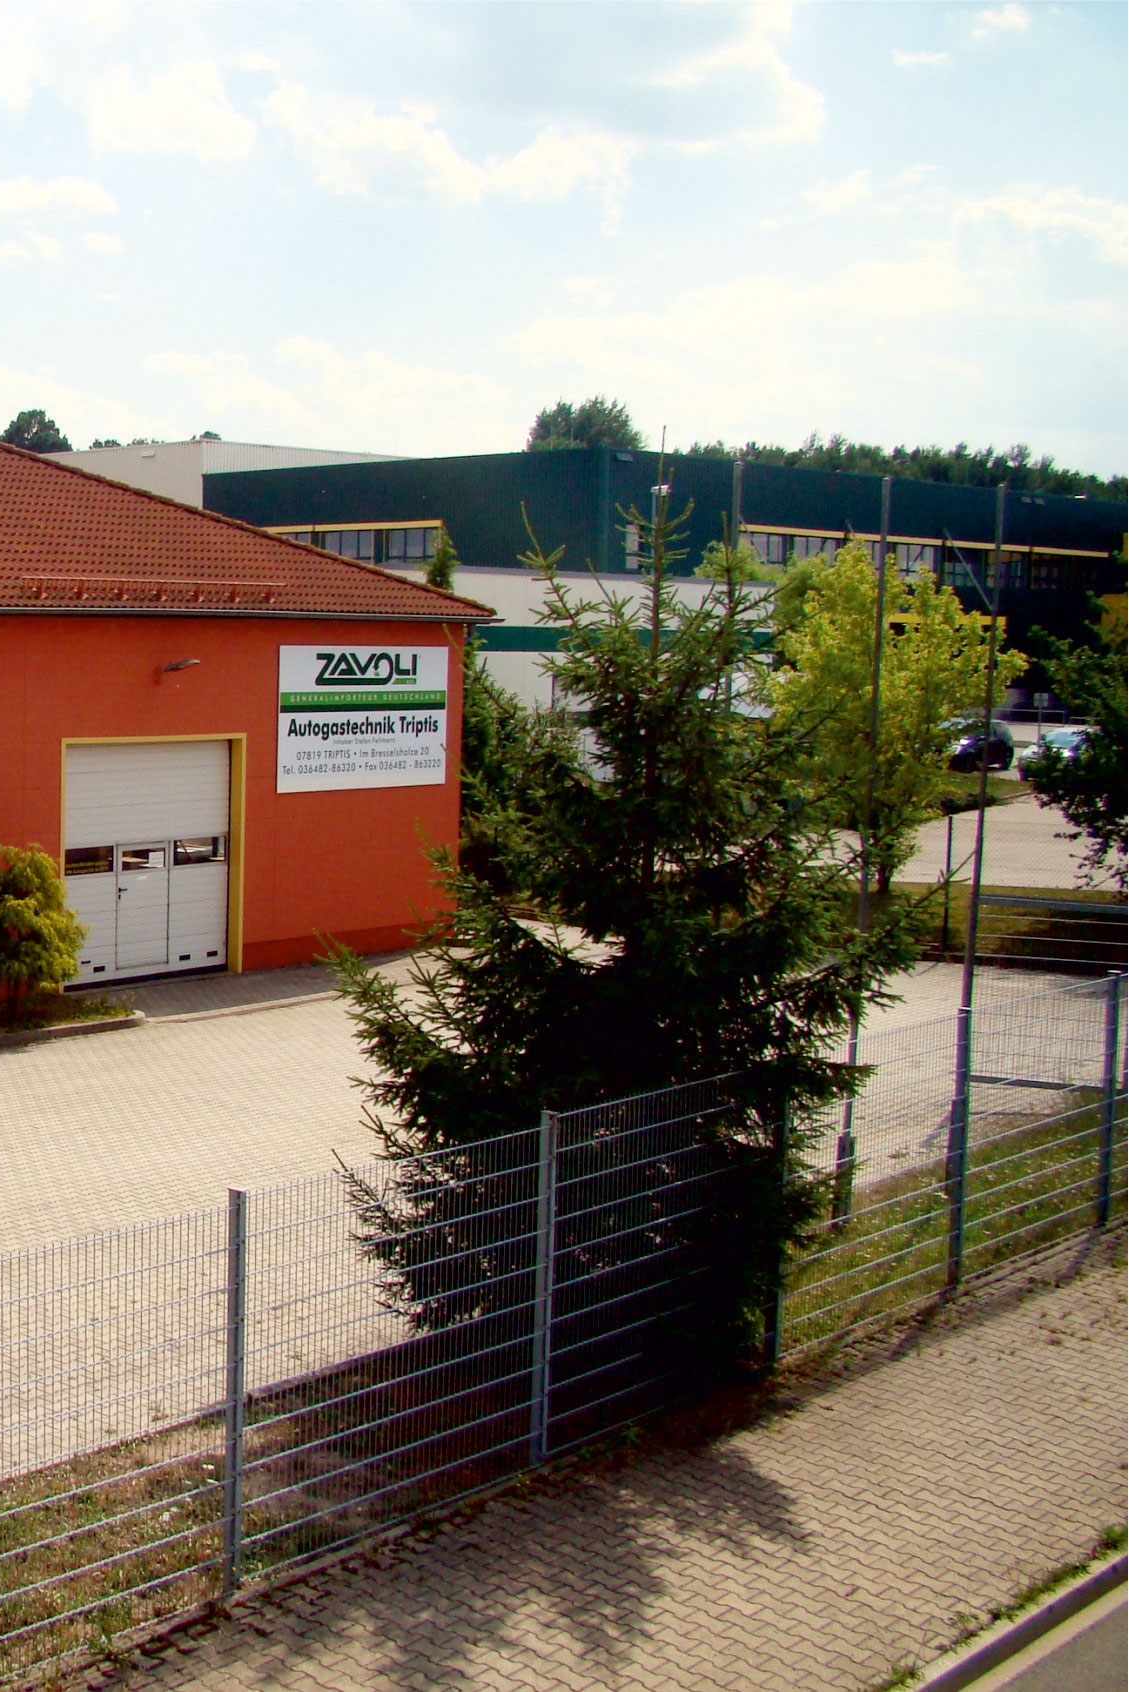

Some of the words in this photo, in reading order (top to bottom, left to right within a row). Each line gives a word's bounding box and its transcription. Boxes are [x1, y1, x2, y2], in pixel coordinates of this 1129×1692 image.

[315, 652, 418, 686] ZAVOLI
[382, 693, 442, 701] DEUTSCHLAND
[287, 715, 395, 741] Autogastechnik
[399, 715, 439, 738] Triptis
[296, 751, 322, 761] 07819
[324, 749, 351, 759] TRIPTIS
[359, 749, 369, 758] Im
[420, 746, 430, 756] 20
[282, 765, 296, 775] Tel.
[364, 761, 377, 771] Fax
